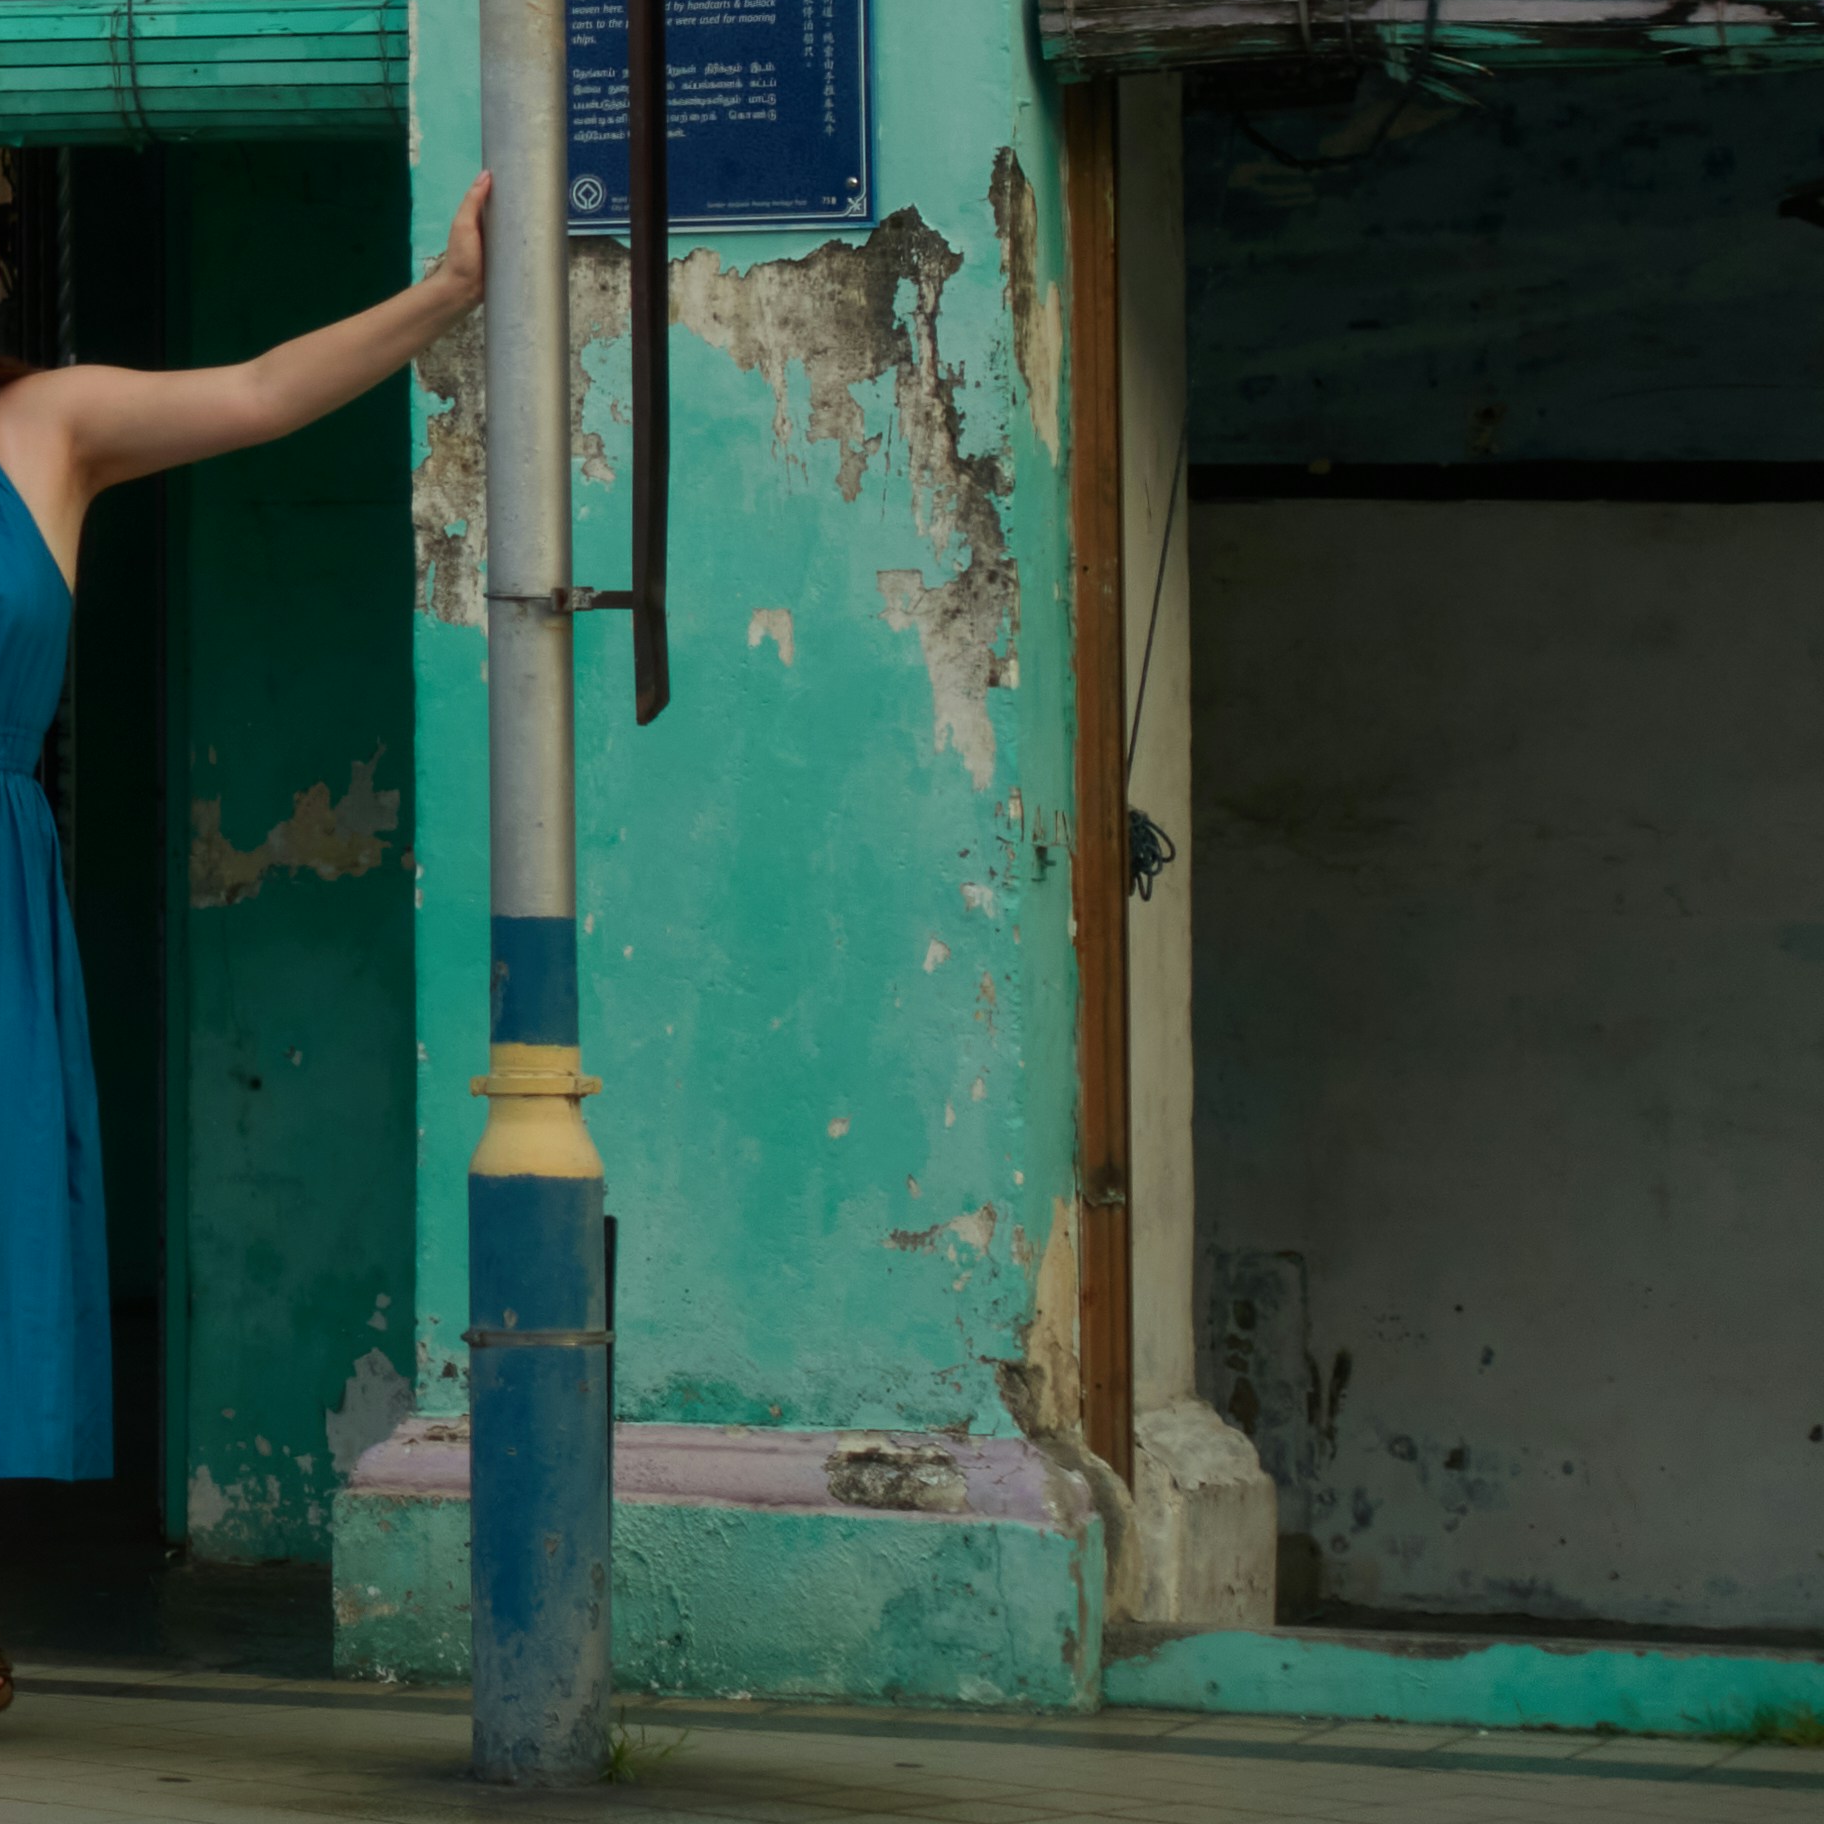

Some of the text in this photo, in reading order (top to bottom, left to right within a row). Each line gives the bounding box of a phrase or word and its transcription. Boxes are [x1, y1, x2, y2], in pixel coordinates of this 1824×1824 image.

[673, 1, 685, 12] by
[596, 19, 605, 29] to
[608, 18, 623, 28] the
[675, 16, 697, 25] were
[700, 14, 720, 24] used
[723, 13, 736, 24] for
[739, 12, 776, 24] mooring
